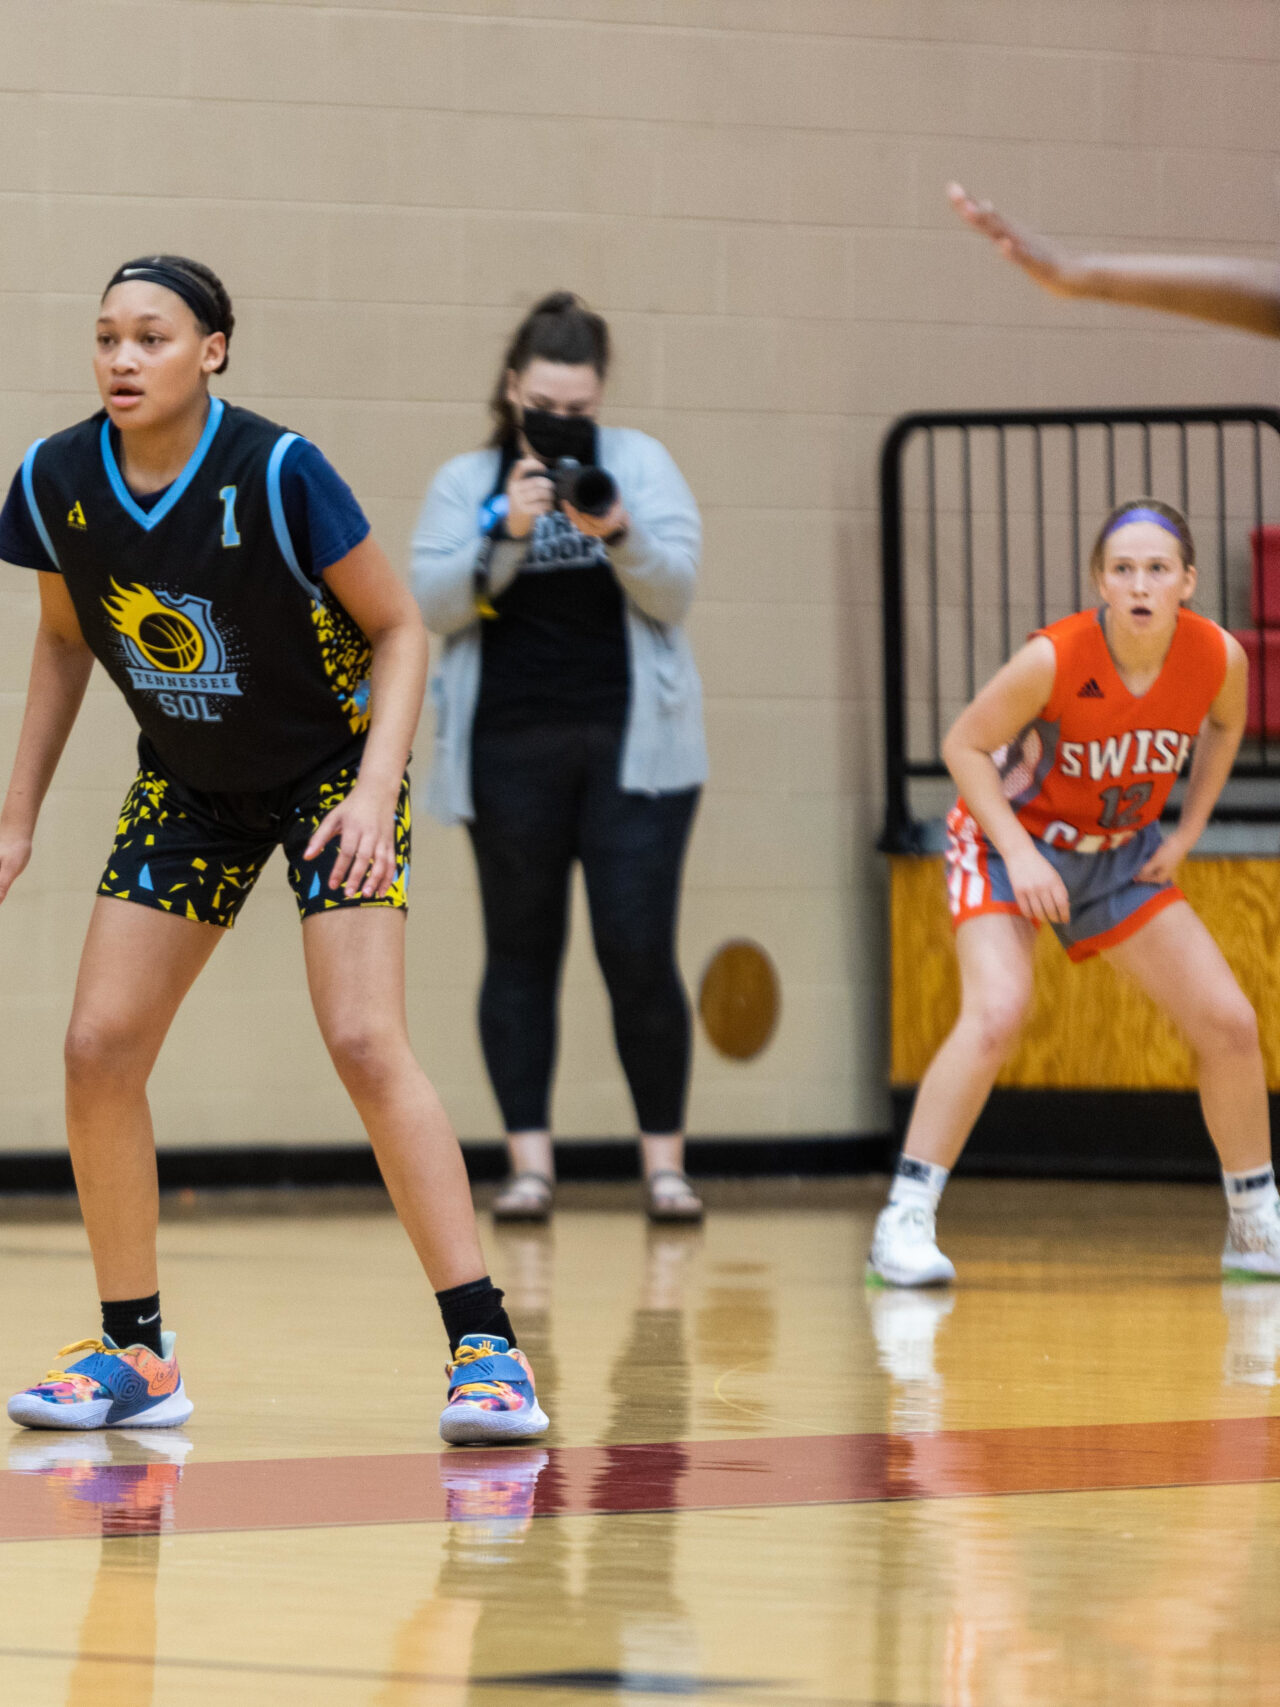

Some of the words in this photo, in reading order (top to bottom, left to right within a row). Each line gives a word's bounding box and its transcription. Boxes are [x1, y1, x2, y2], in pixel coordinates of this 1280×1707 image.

[219, 485, 241, 547] 1
[133, 672, 232, 689] TENNESSEE
[157, 693, 223, 721] SOL
[1098, 781, 1155, 828] 12
